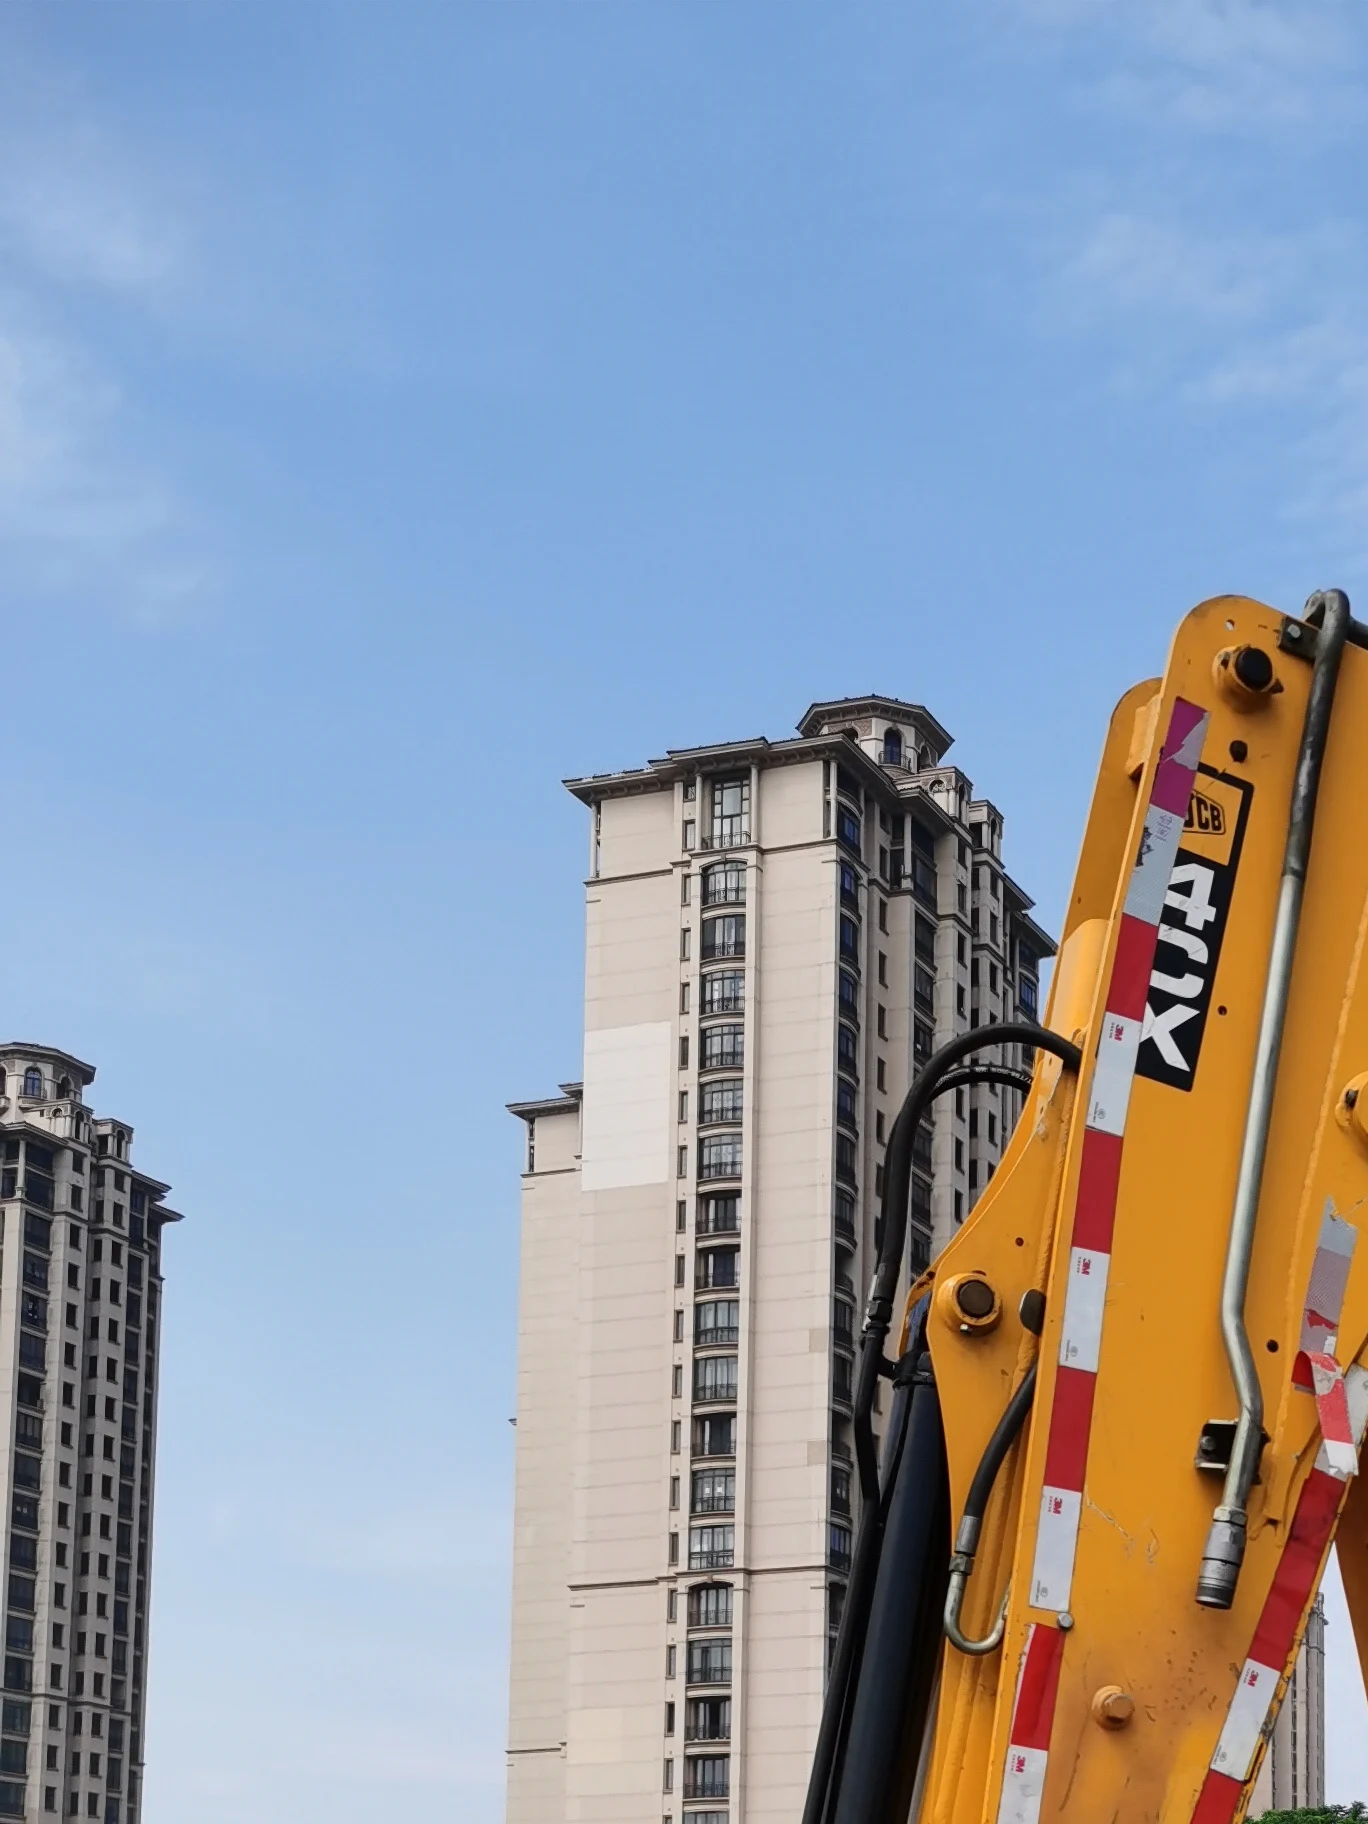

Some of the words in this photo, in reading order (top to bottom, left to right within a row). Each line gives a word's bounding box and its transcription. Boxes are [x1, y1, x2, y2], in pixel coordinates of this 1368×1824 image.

[1115, 1024, 1124, 1041] 3M
[1081, 1258, 1091, 1275] 3M
[1053, 1497, 1063, 1514] 3M
[1248, 1670, 1259, 1687] 3M
[1015, 1755, 1025, 1773] 3M
